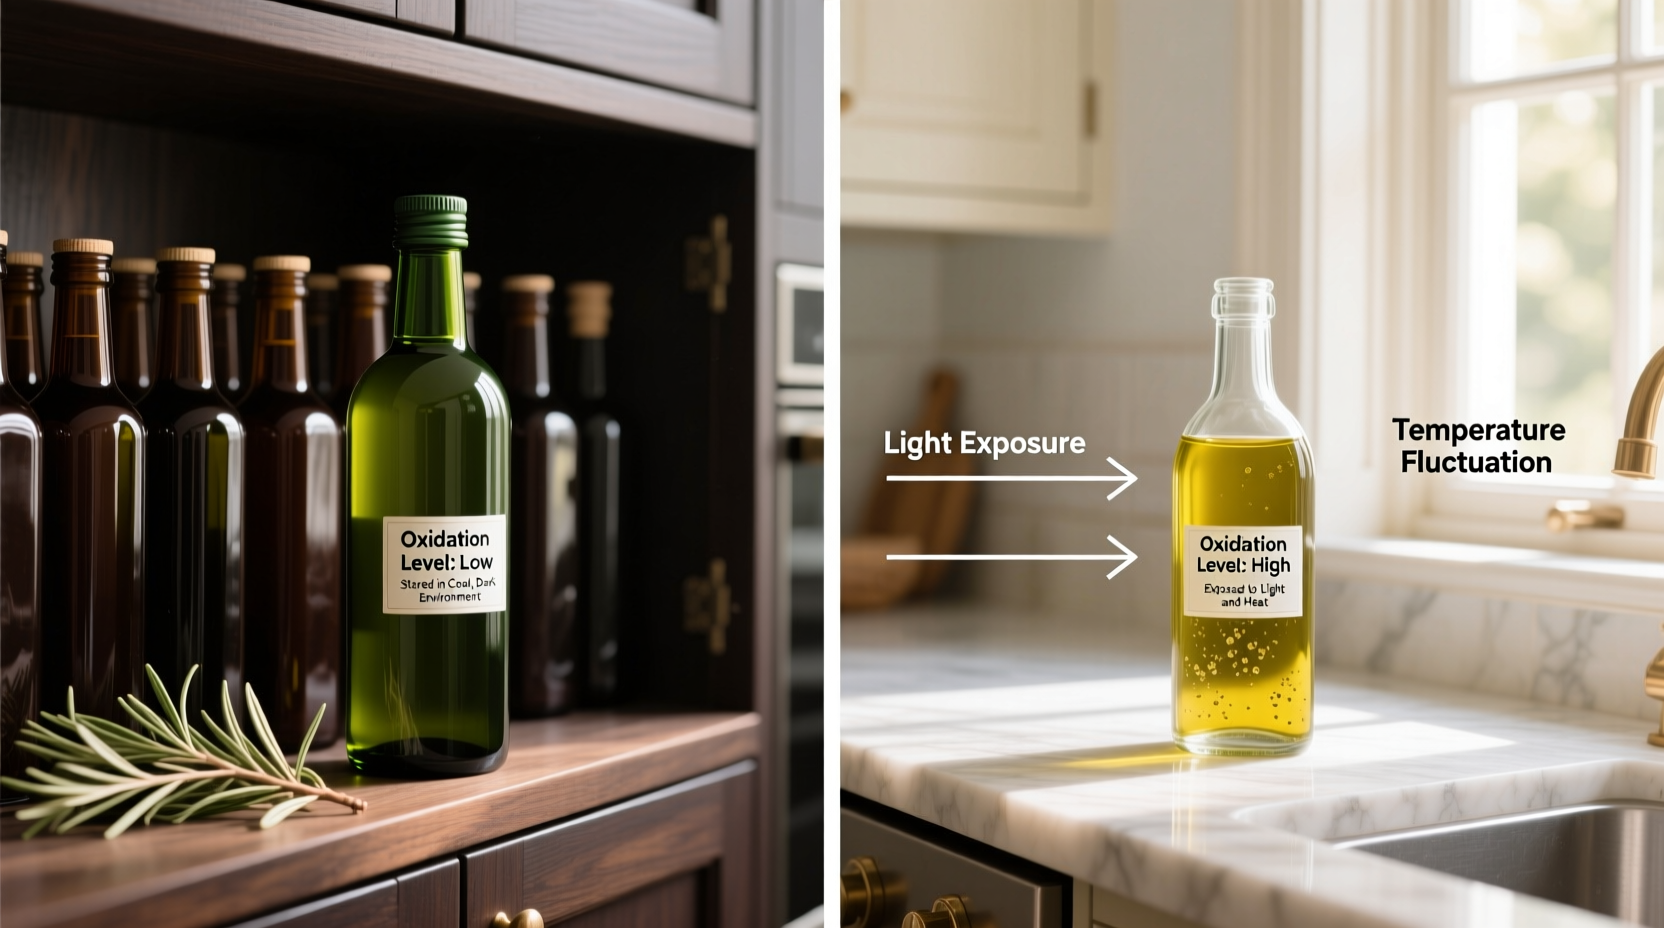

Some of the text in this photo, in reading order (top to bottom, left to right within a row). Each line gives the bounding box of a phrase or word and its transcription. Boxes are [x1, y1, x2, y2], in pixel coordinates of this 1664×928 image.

[401, 529, 489, 548] Oxidation
[1200, 535, 1287, 552] Oxidation
[401, 554, 494, 571] Level: Low
[1197, 557, 1291, 577] Level: High
[436, 577, 446, 589] in
[1221, 596, 1269, 607] and Heat
